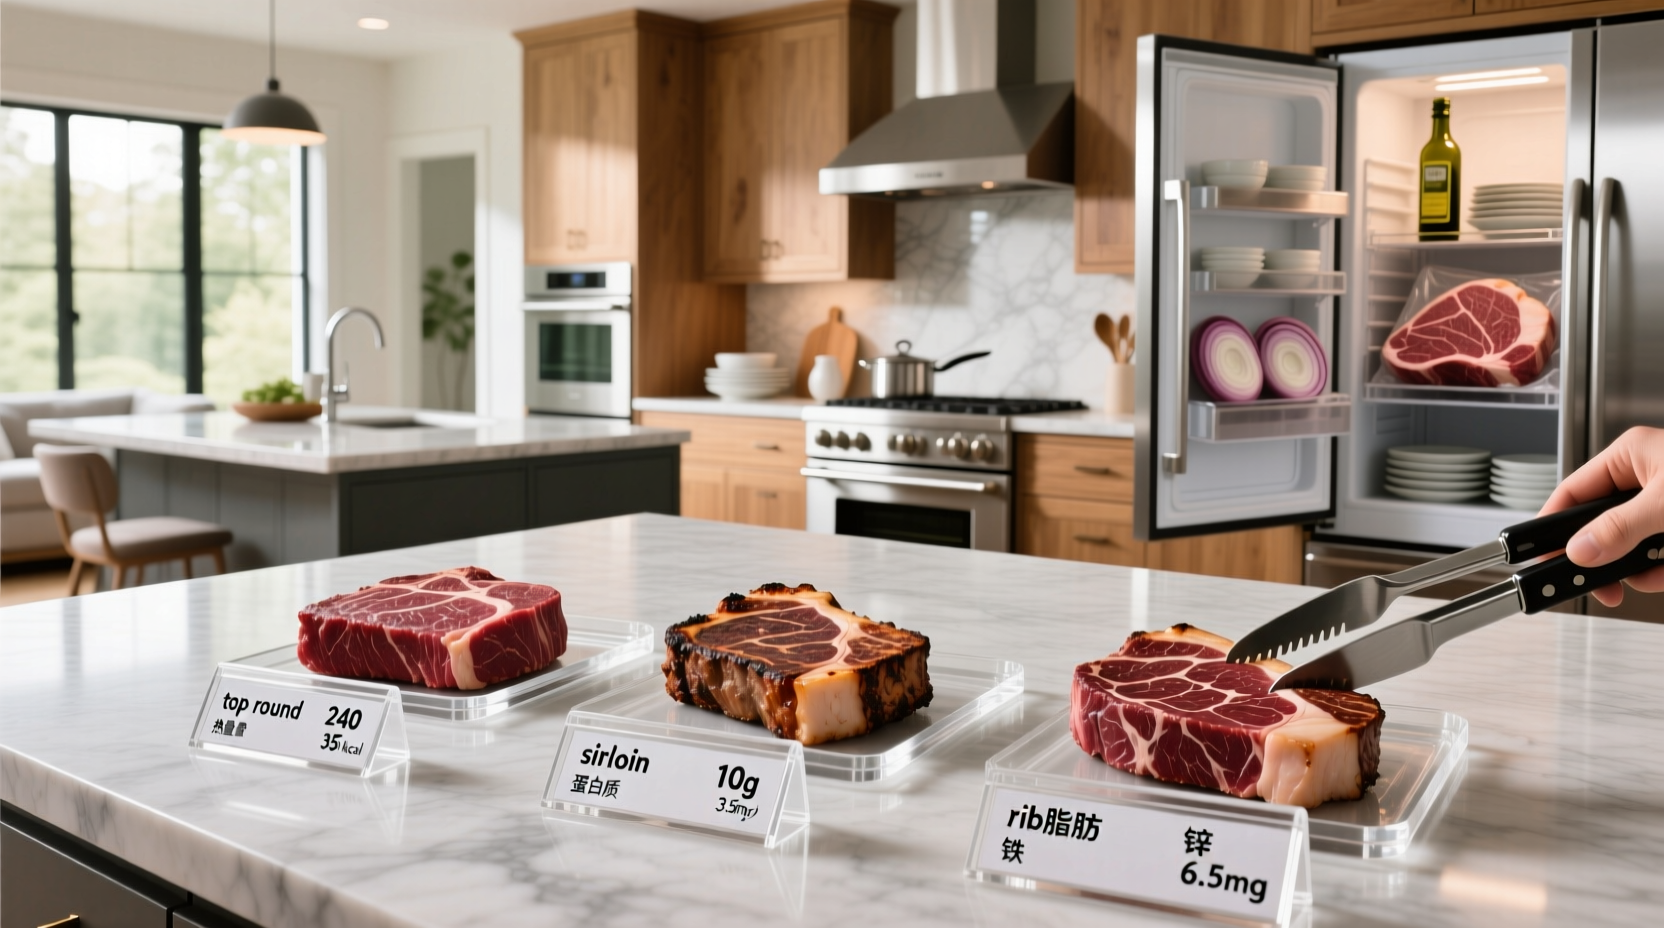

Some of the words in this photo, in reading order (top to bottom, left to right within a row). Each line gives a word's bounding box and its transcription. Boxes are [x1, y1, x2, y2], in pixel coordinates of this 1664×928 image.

[222, 691, 249, 717] top
[252, 700, 305, 720] round
[324, 705, 363, 730] 240
[580, 742, 650, 774] sirloin
[717, 764, 760, 800] 10g
[1001, 836, 1025, 864] 铁
[1184, 826, 1214, 857] 锌
[1180, 861, 1268, 904] 6.5mg
